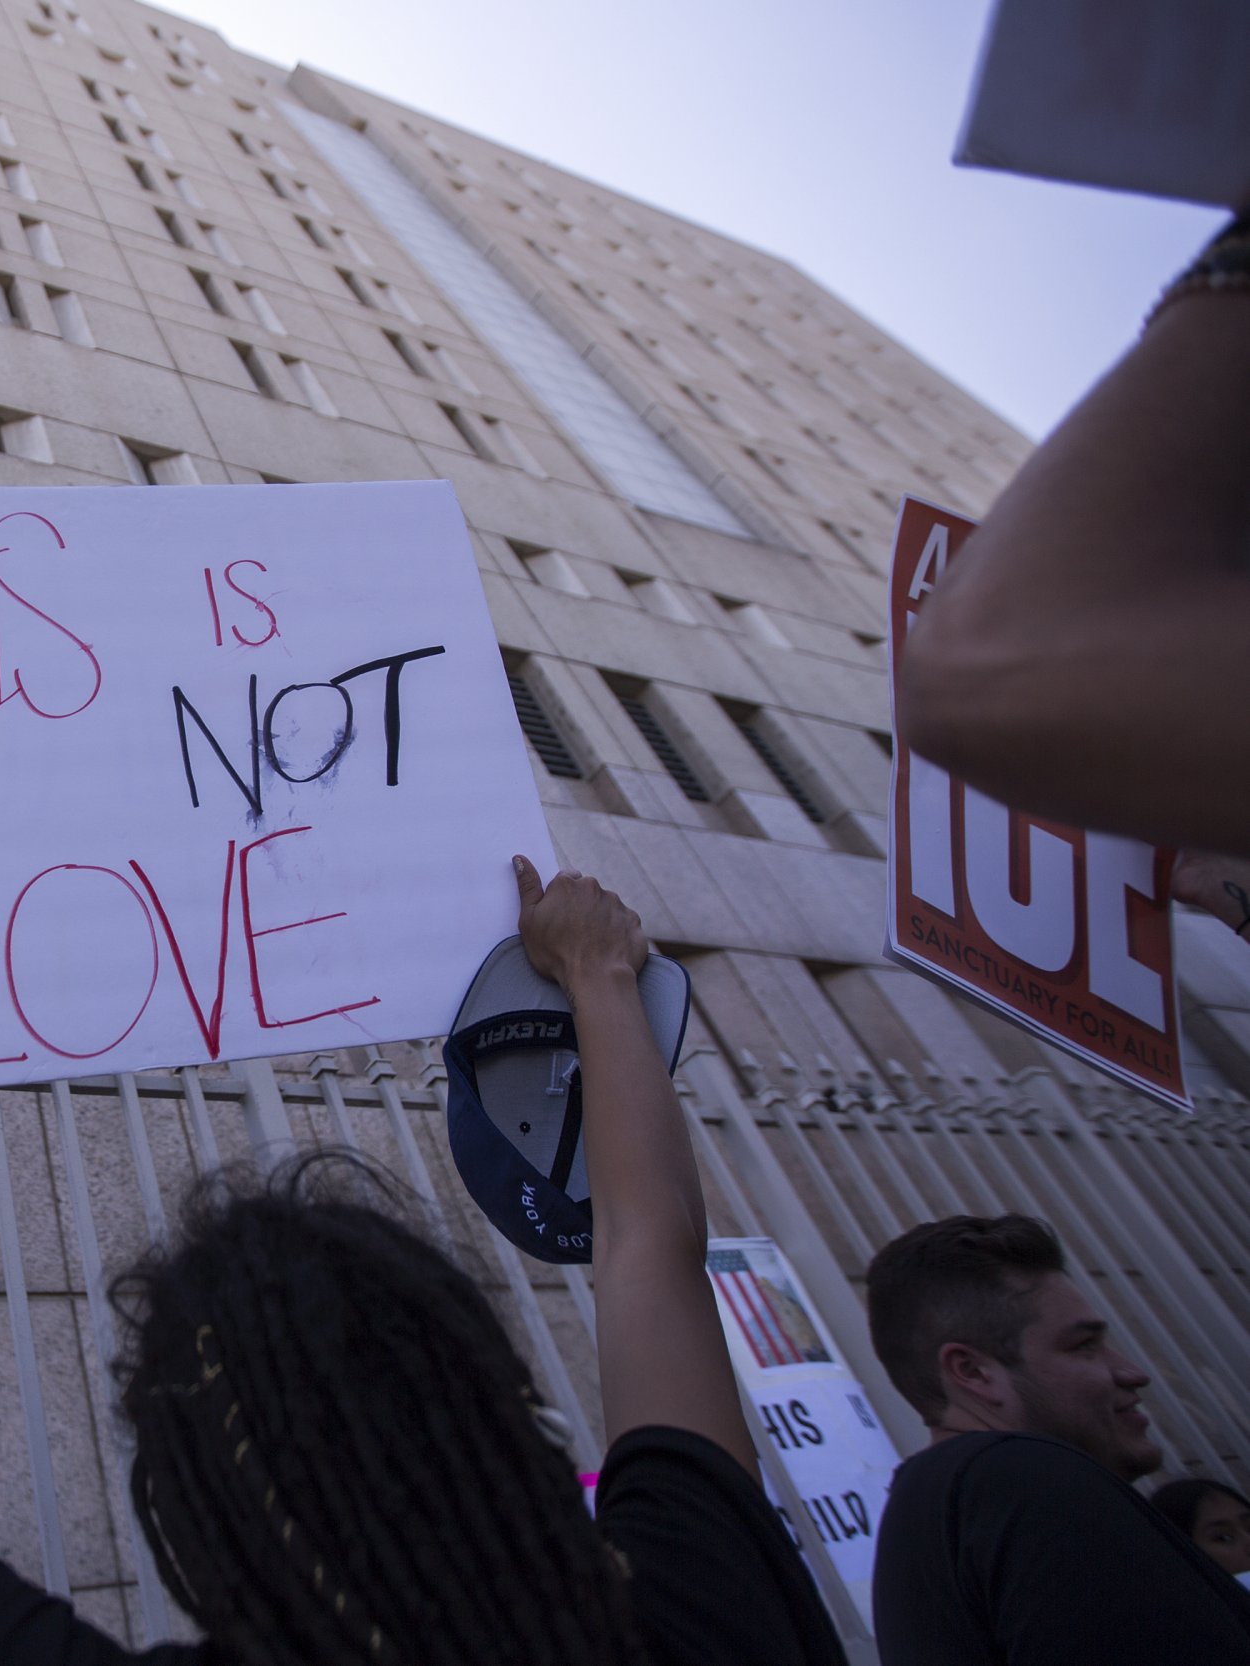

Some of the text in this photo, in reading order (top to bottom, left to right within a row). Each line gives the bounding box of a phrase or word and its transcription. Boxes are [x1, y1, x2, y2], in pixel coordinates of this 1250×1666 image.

[204, 559, 281, 647] IS
[172, 645, 445, 816] NOT
[910, 914, 1173, 1078] SANCTUARY FOR ALL!
[475, 1021, 564, 1050] FLEXFIT
[521, 1180, 547, 1236] YORK
[756, 1398, 824, 1459] HIS
